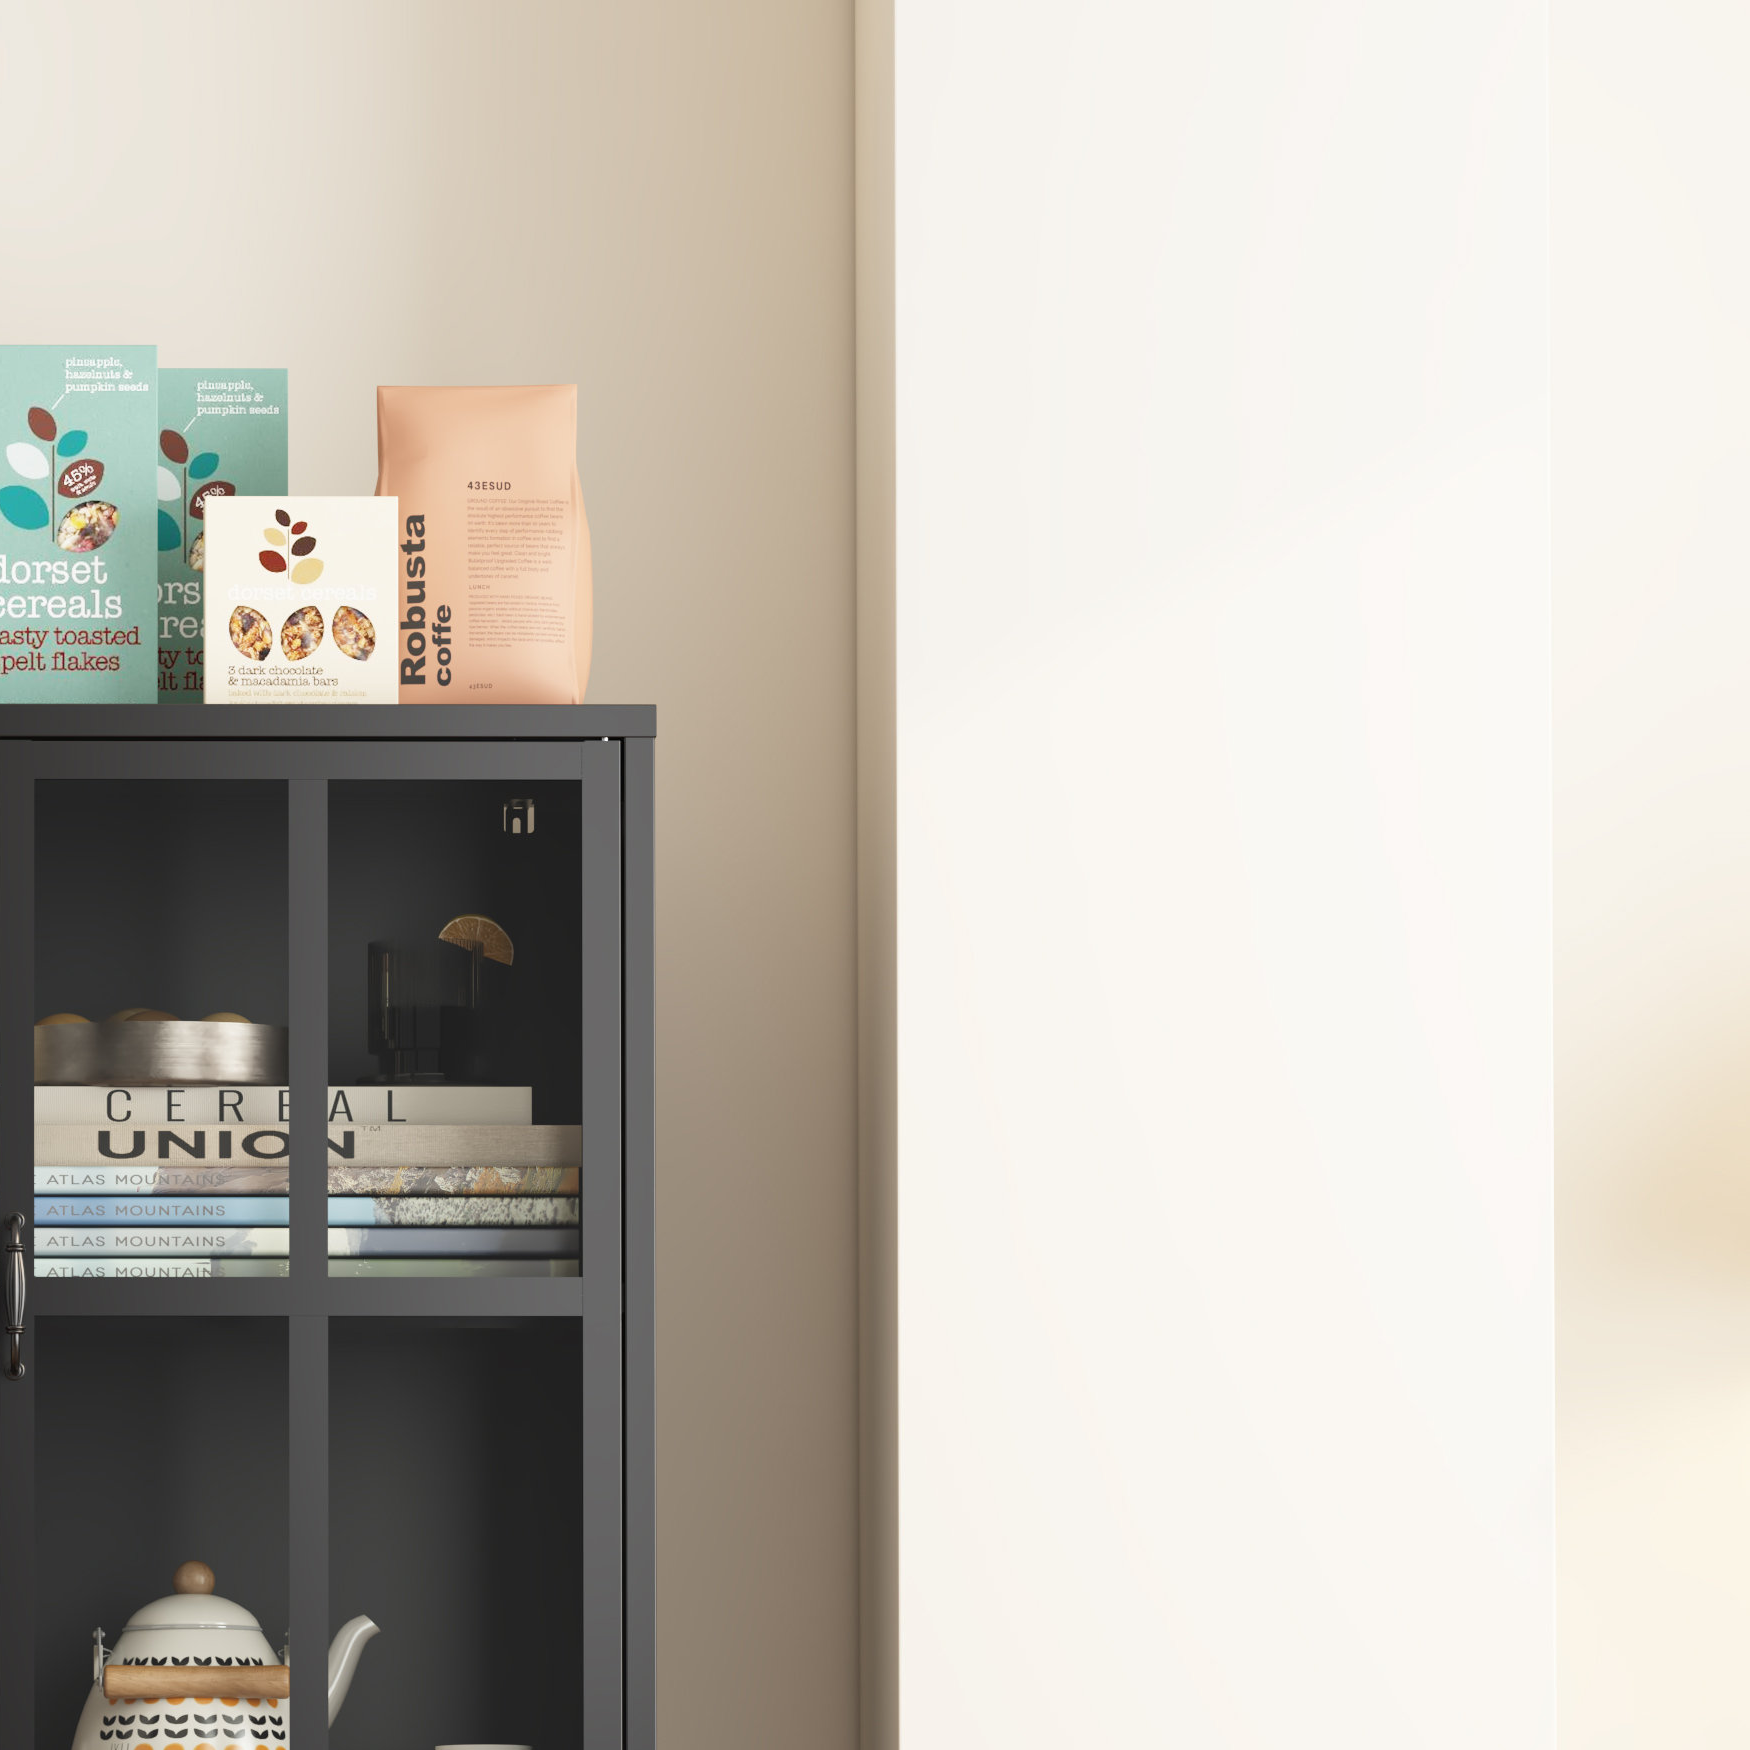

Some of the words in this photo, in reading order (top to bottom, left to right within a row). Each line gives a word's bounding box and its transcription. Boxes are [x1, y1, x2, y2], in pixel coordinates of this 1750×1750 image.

[65, 357, 123, 369] pineapple,
[65, 369, 120, 379] hazelnuts
[123, 370, 133, 379] &
[65, 382, 116, 393] pumpkin
[118, 382, 149, 392] seeds
[197, 380, 254, 392] pineapple,
[197, 393, 251, 403] hazelnuts
[254, 393, 264, 403] &
[197, 404, 247, 417] pumpkin
[250, 405, 280, 415] seeds
[63, 462, 95, 488] 45%
[467, 481, 511, 491] 43ESUD
[400, 513, 426, 685] Robusta
[53, 626, 142, 646] toasted
[432, 604, 452, 686] coffe
[51, 651, 121, 671] flakes
[228, 665, 235, 675] 3
[238, 665, 266, 675] dark
[268, 665, 324, 675] chocolate
[228, 676, 238, 686] &
[241, 676, 311, 686] macadamia
[313, 676, 339, 686] bars
[106, 1089, 407, 1122] CEREAL
[97, 1130, 355, 1160] UNION
[46, 1173, 106, 1185] ATLAS
[115, 1173, 226, 1185] MOUNTAINS
[46, 1204, 106, 1216] ATLAS
[115, 1204, 226, 1216] MOUNTAINS
[46, 1235, 106, 1247] ATLAS
[115, 1235, 226, 1247] MOUNTAINS
[46, 1266, 106, 1278] ATLAS
